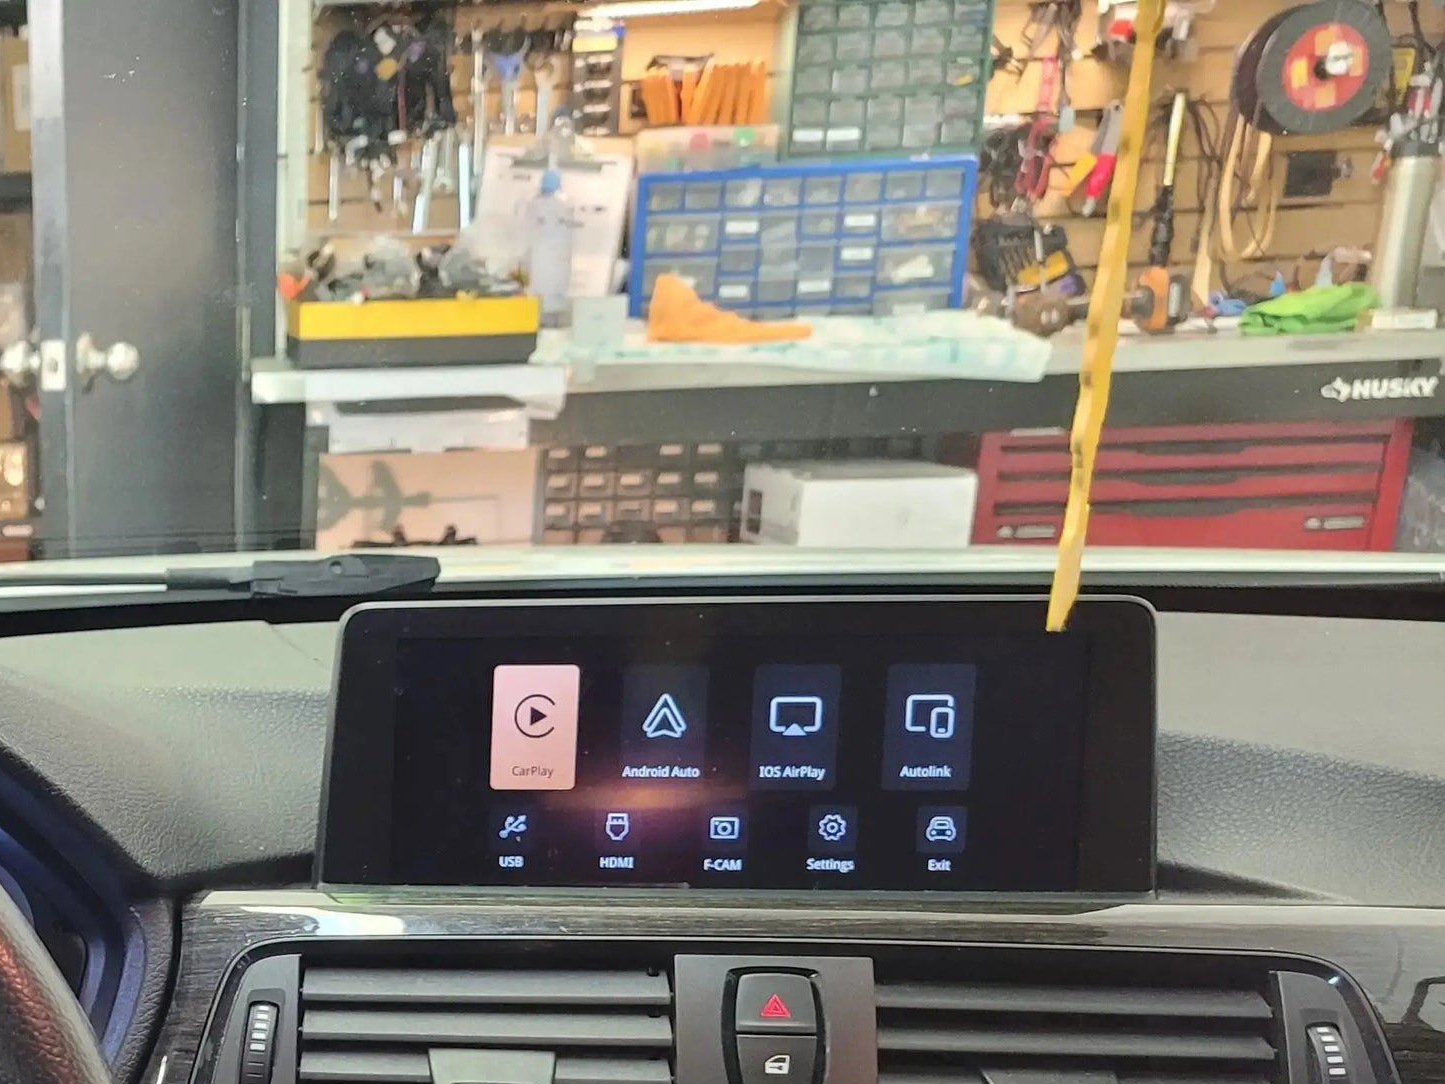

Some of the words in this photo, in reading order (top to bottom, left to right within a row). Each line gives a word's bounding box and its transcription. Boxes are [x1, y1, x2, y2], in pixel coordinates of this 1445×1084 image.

[511, 766, 554, 779] CarPlay
[622, 766, 670, 778] Android
[671, 766, 700, 778] Auto
[759, 766, 779, 778] IOS
[782, 765, 825, 781] AirPlay
[900, 765, 951, 778] Autolink
[498, 856, 523, 868] USB
[599, 857, 634, 869] HDMI
[703, 859, 742, 872] F-CAM
[806, 858, 854, 873] Settings
[927, 859, 950, 872] Exit
